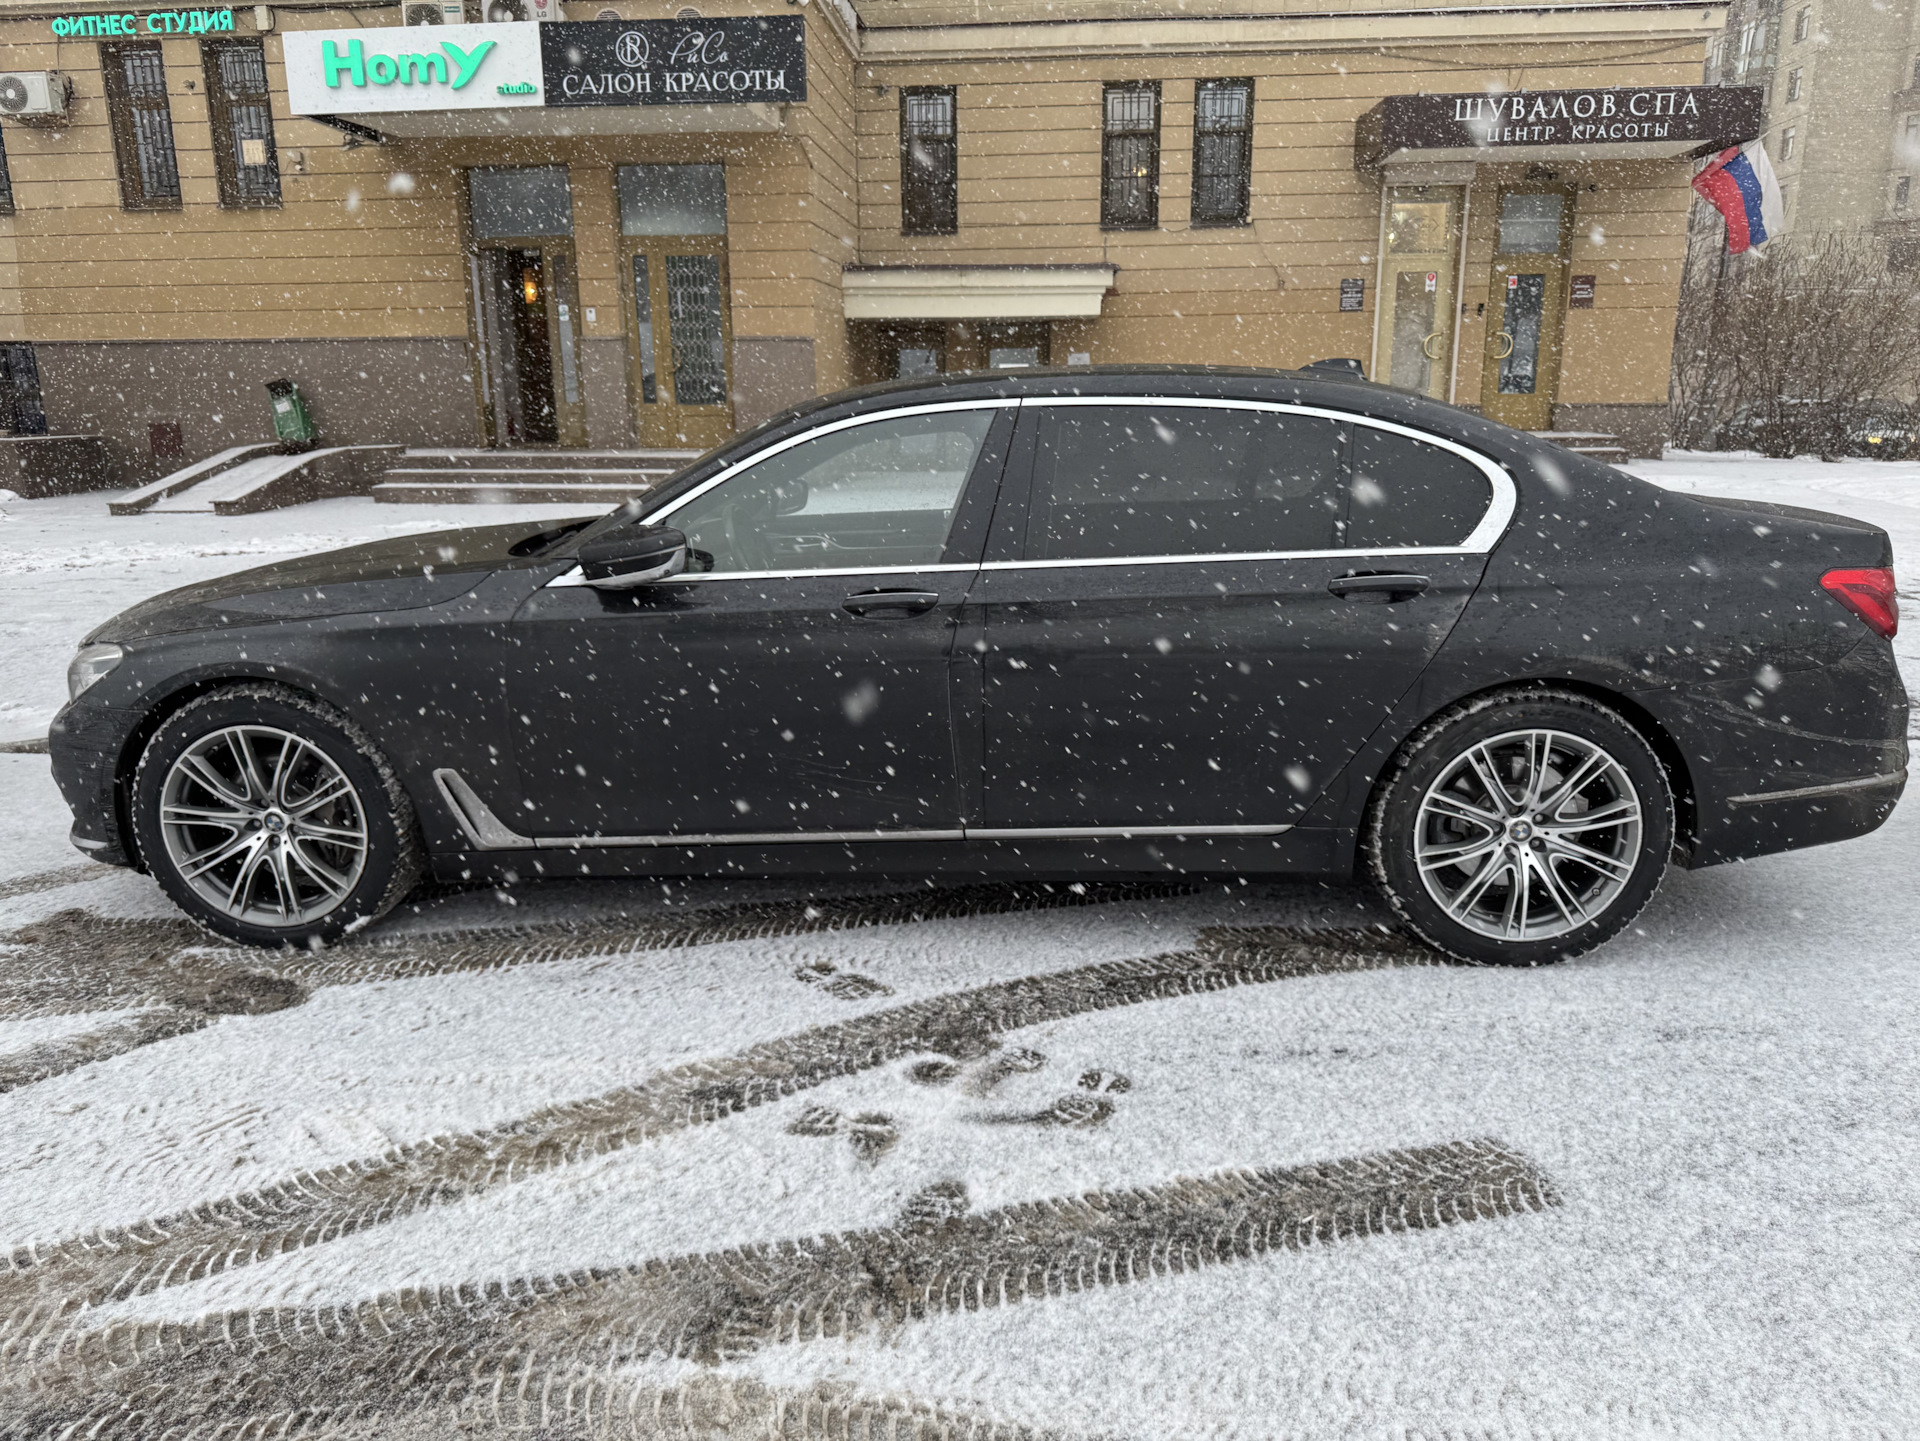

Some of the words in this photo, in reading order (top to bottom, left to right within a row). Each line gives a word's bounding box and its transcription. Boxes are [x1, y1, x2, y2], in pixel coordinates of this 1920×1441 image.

[51, 15, 137, 37] ФИТНЕС
[146, 10, 235, 35] СТУДИЯ
[536, 10, 547, 18] LG
[496, 81, 537, 95] studio
[562, 73, 651, 95] САЛОН
[664, 69, 791, 93] КРАСОТЫ
[1454, 94, 1617, 122] ШУВАЛОВ
[1629, 92, 1699, 116] СПА
[1487, 126, 1555, 142] ЦЕНТР
[1572, 122, 1669, 139] КРАСОТЫ
